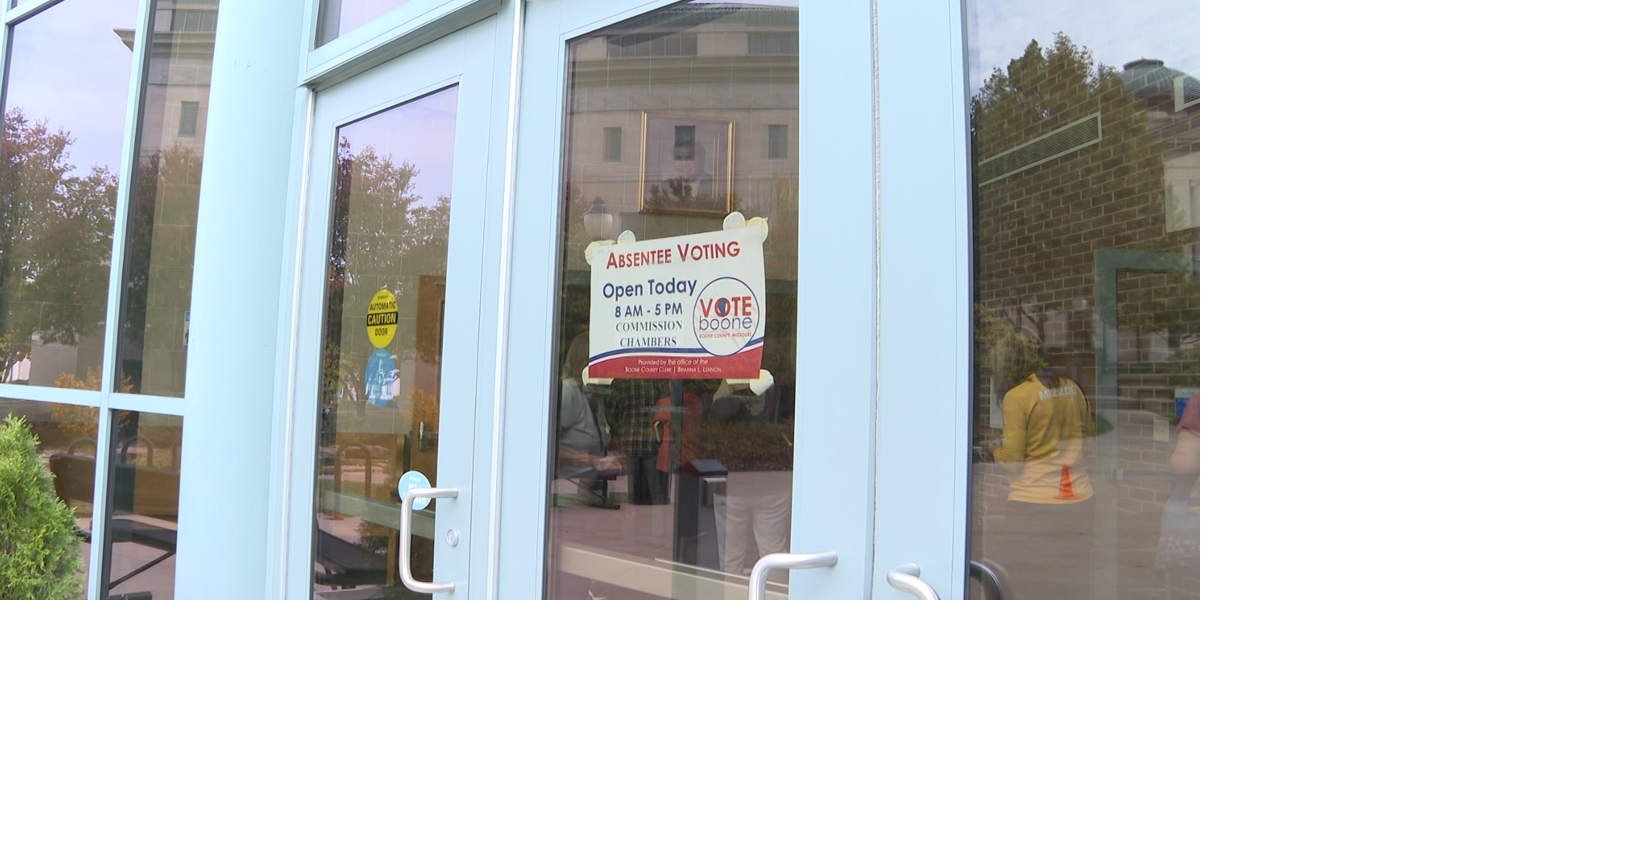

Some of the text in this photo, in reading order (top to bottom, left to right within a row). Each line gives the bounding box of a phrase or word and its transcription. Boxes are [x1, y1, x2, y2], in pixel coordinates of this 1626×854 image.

[606, 240, 740, 270] ABSENTEE VOTING
[602, 277, 697, 302] Open Today
[370, 301, 396, 311] AUTOMATIC
[614, 305, 622, 318] 8
[624, 304, 643, 317] AM
[654, 303, 661, 316] 5
[665, 302, 683, 315] PM
[699, 295, 752, 318] VOTE
[367, 313, 397, 325] CAUTION
[615, 320, 683, 332] COMMISSION
[699, 315, 752, 330] boone
[374, 327, 388, 336] DOOR
[620, 337, 677, 347] CHAMBERS
[1038, 386, 1078, 400] MIZZOU
